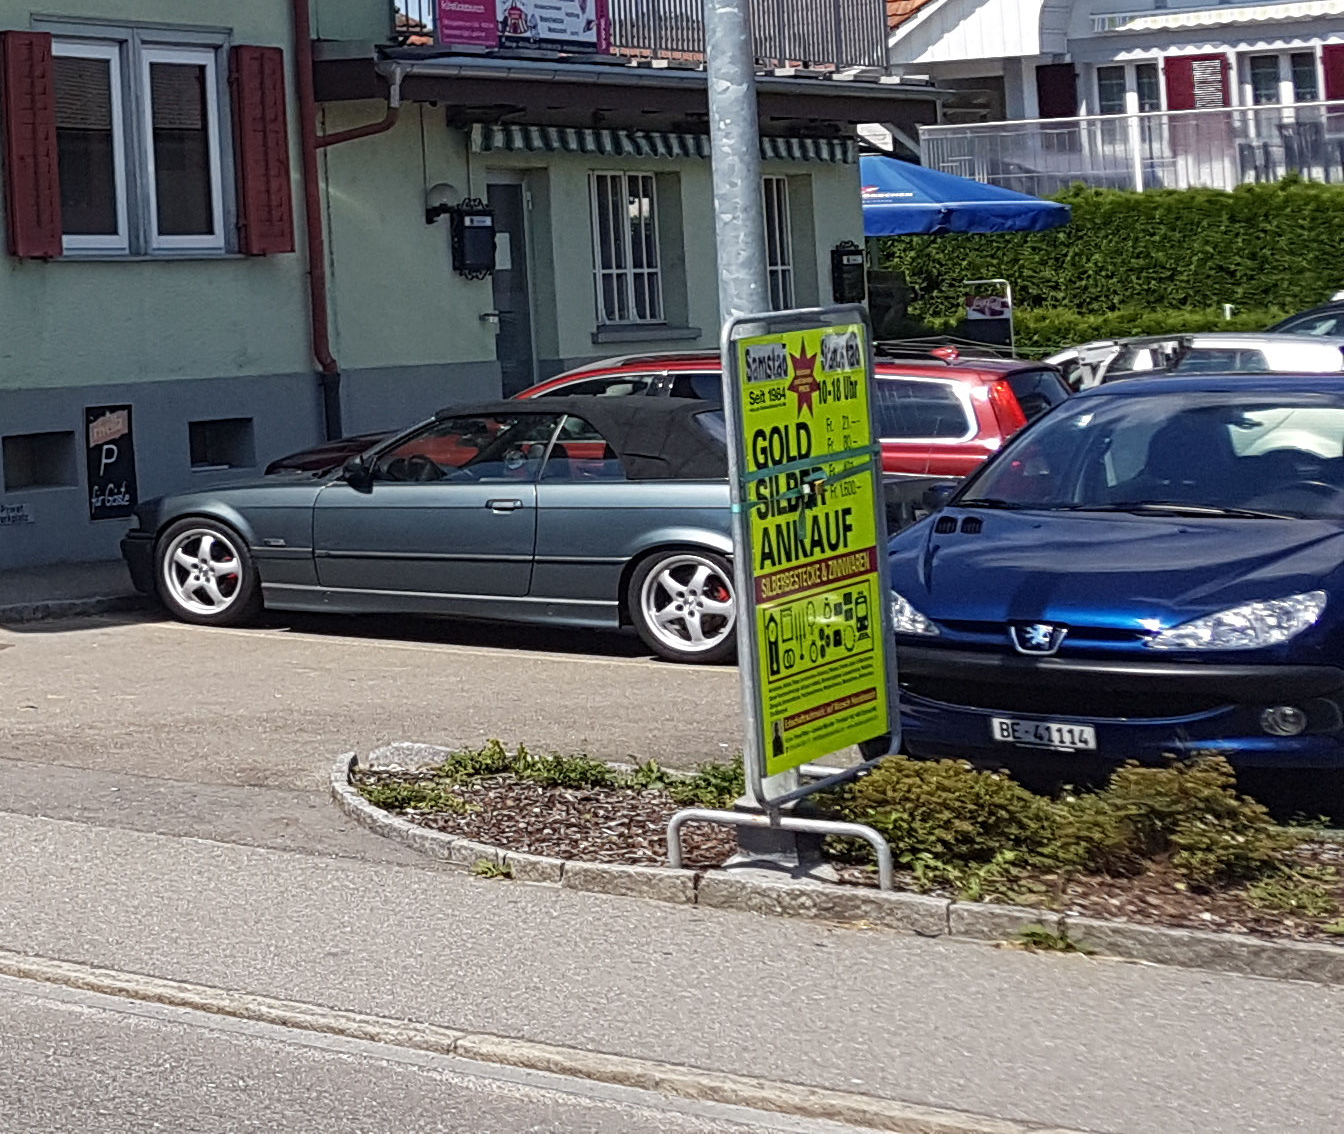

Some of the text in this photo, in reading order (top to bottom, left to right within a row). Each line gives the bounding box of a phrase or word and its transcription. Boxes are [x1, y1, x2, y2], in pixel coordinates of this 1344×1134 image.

[749, 390, 766, 405] Seit
[818, 377, 842, 404] 10-18
[843, 375, 858, 401] Uhr
[100, 444, 118, 476] P
[752, 422, 813, 470] GOLD
[91, 485, 105, 514] für
[760, 507, 853, 570] ANKAUF
[821, 562, 828, 581] &
